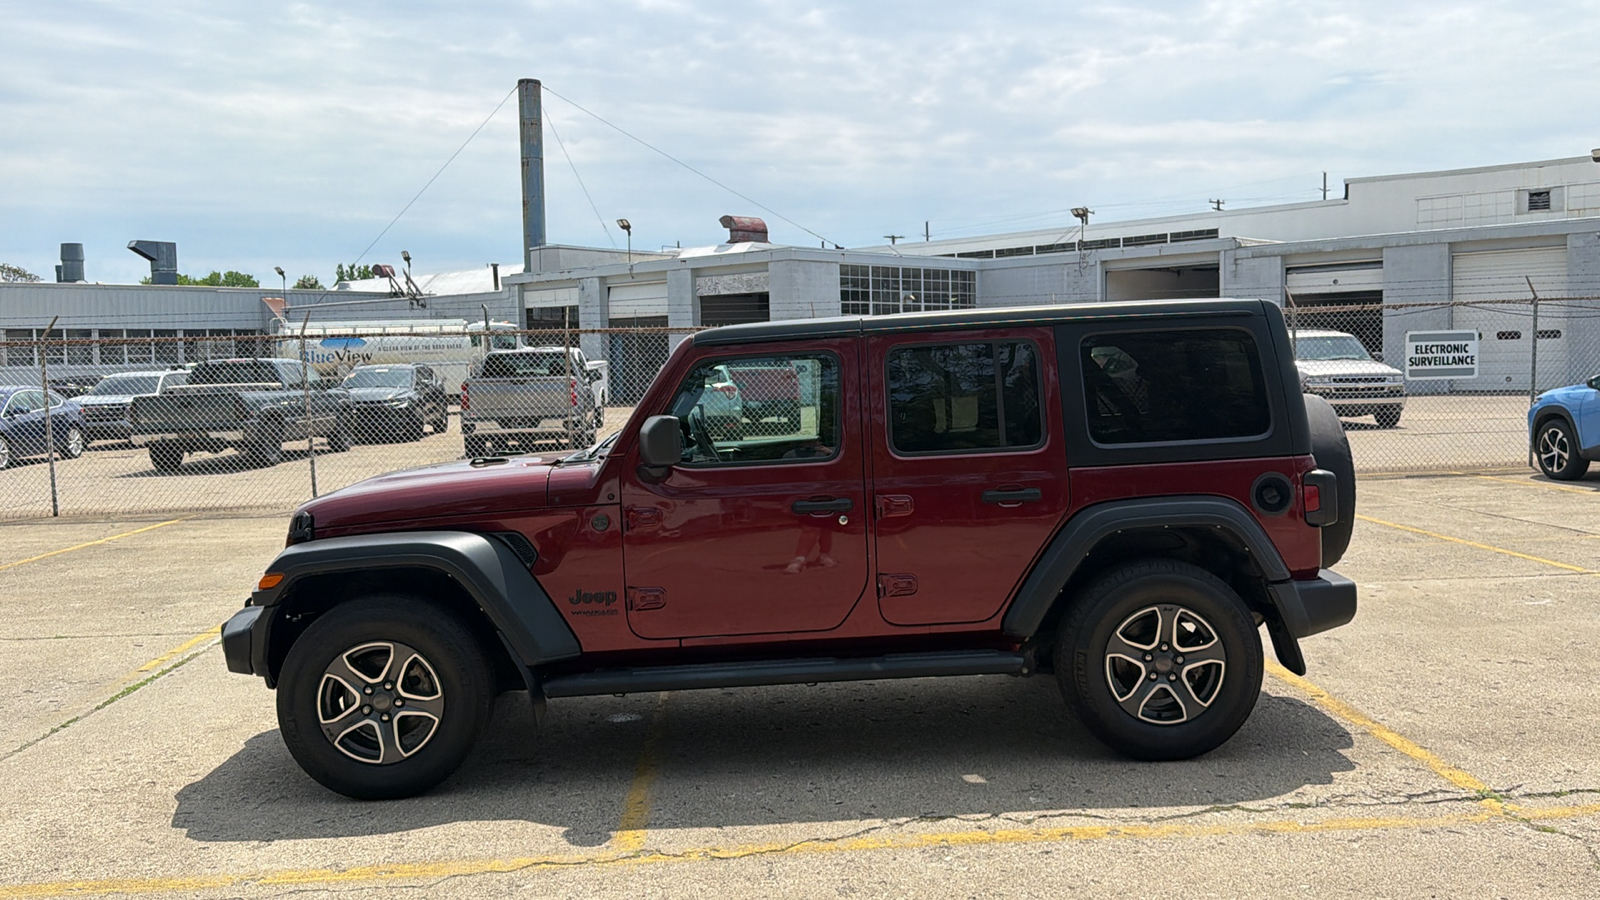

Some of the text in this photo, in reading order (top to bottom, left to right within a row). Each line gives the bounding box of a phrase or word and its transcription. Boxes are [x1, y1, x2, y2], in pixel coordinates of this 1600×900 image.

[1415, 344, 1469, 354] ELECTRONIC
[1409, 355, 1475, 367] SURVEILLANCE
[569, 589, 617, 606] Jeep
